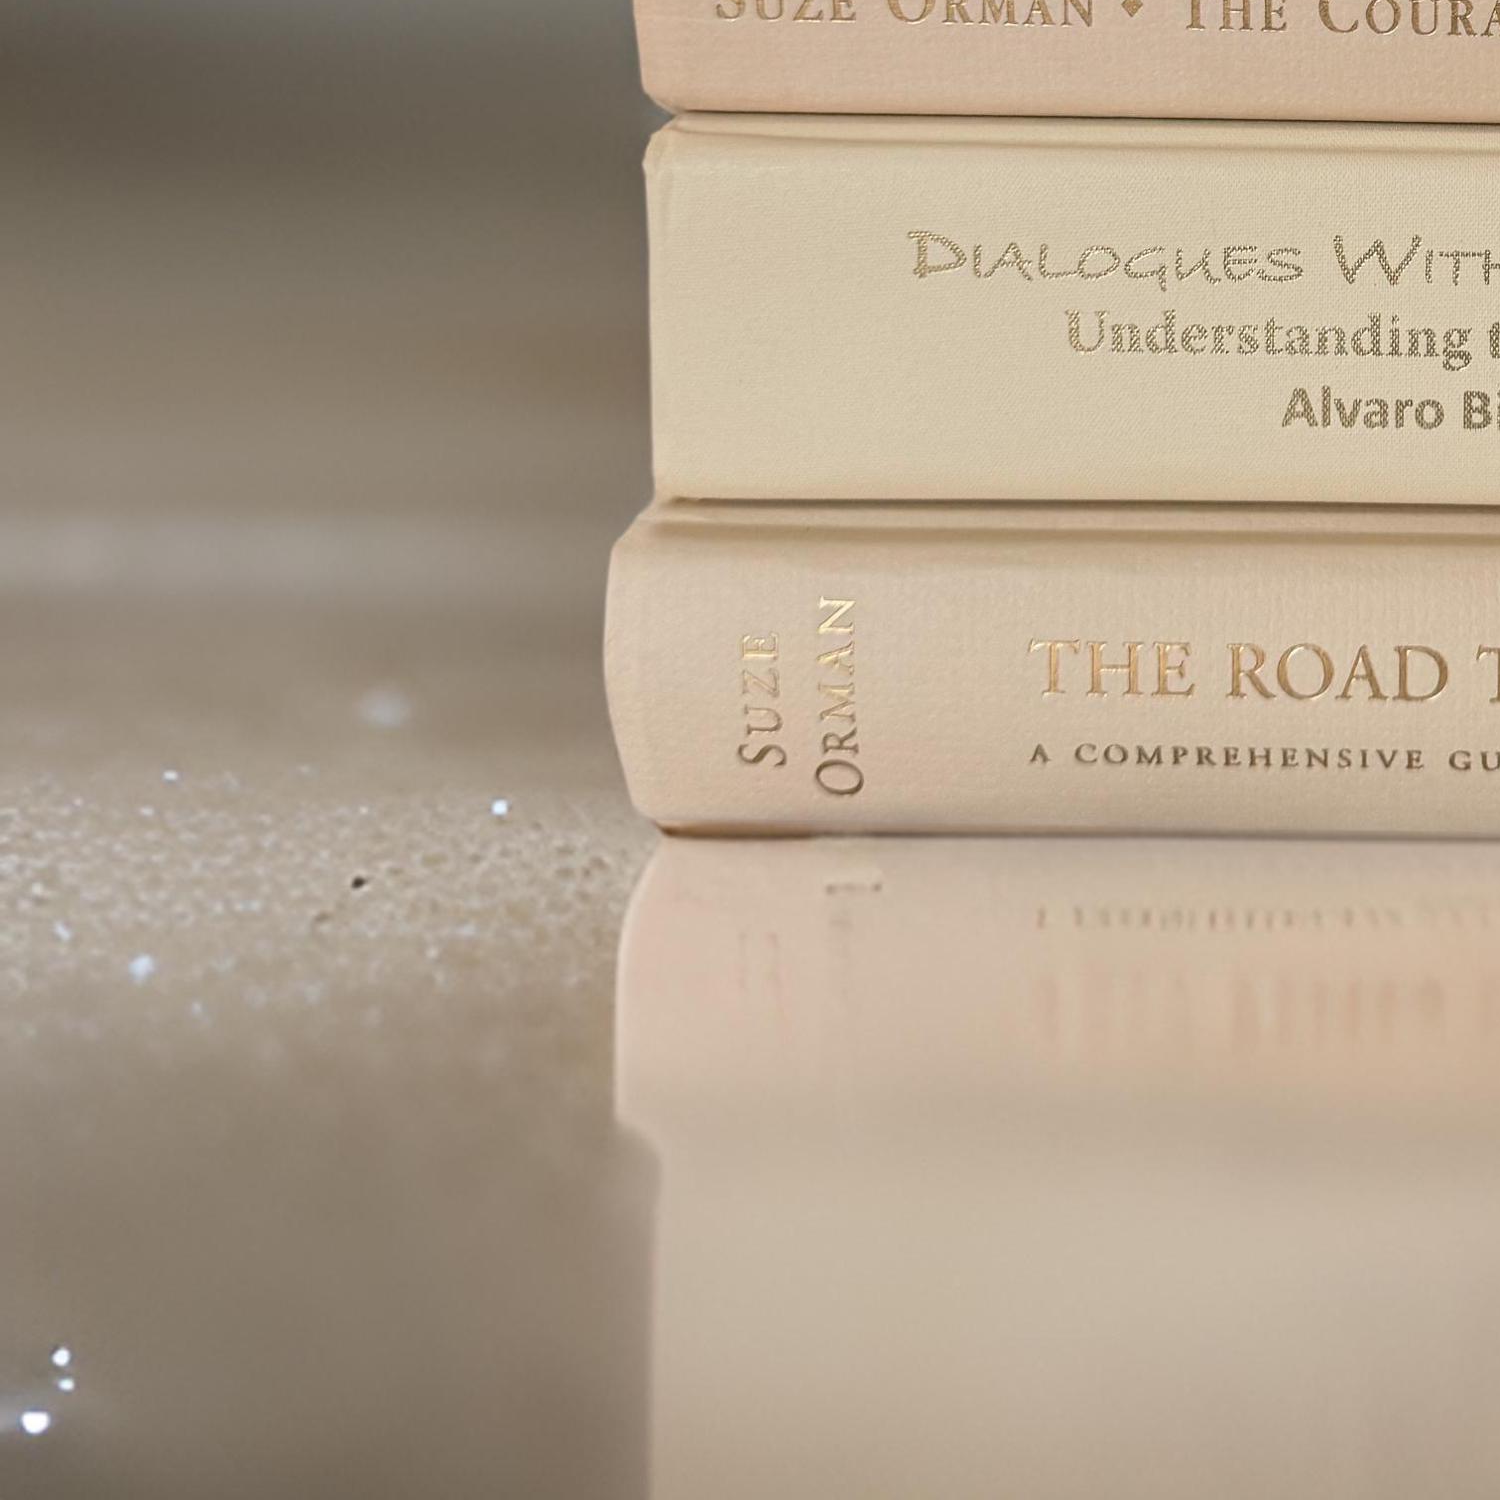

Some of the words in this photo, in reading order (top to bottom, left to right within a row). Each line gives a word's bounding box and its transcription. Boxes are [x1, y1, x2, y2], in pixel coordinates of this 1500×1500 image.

[1066, 309, 1473, 372] Understanding
[1281, 386, 1445, 430] Alvaro
[738, 632, 788, 769] SUZE
[814, 596, 865, 797] ORMAN
[1028, 638, 1196, 697] THE
[1226, 643, 1450, 701] ROAD
[1029, 743, 1051, 766] A
[1075, 743, 1425, 771] COMPREHENSIVE
